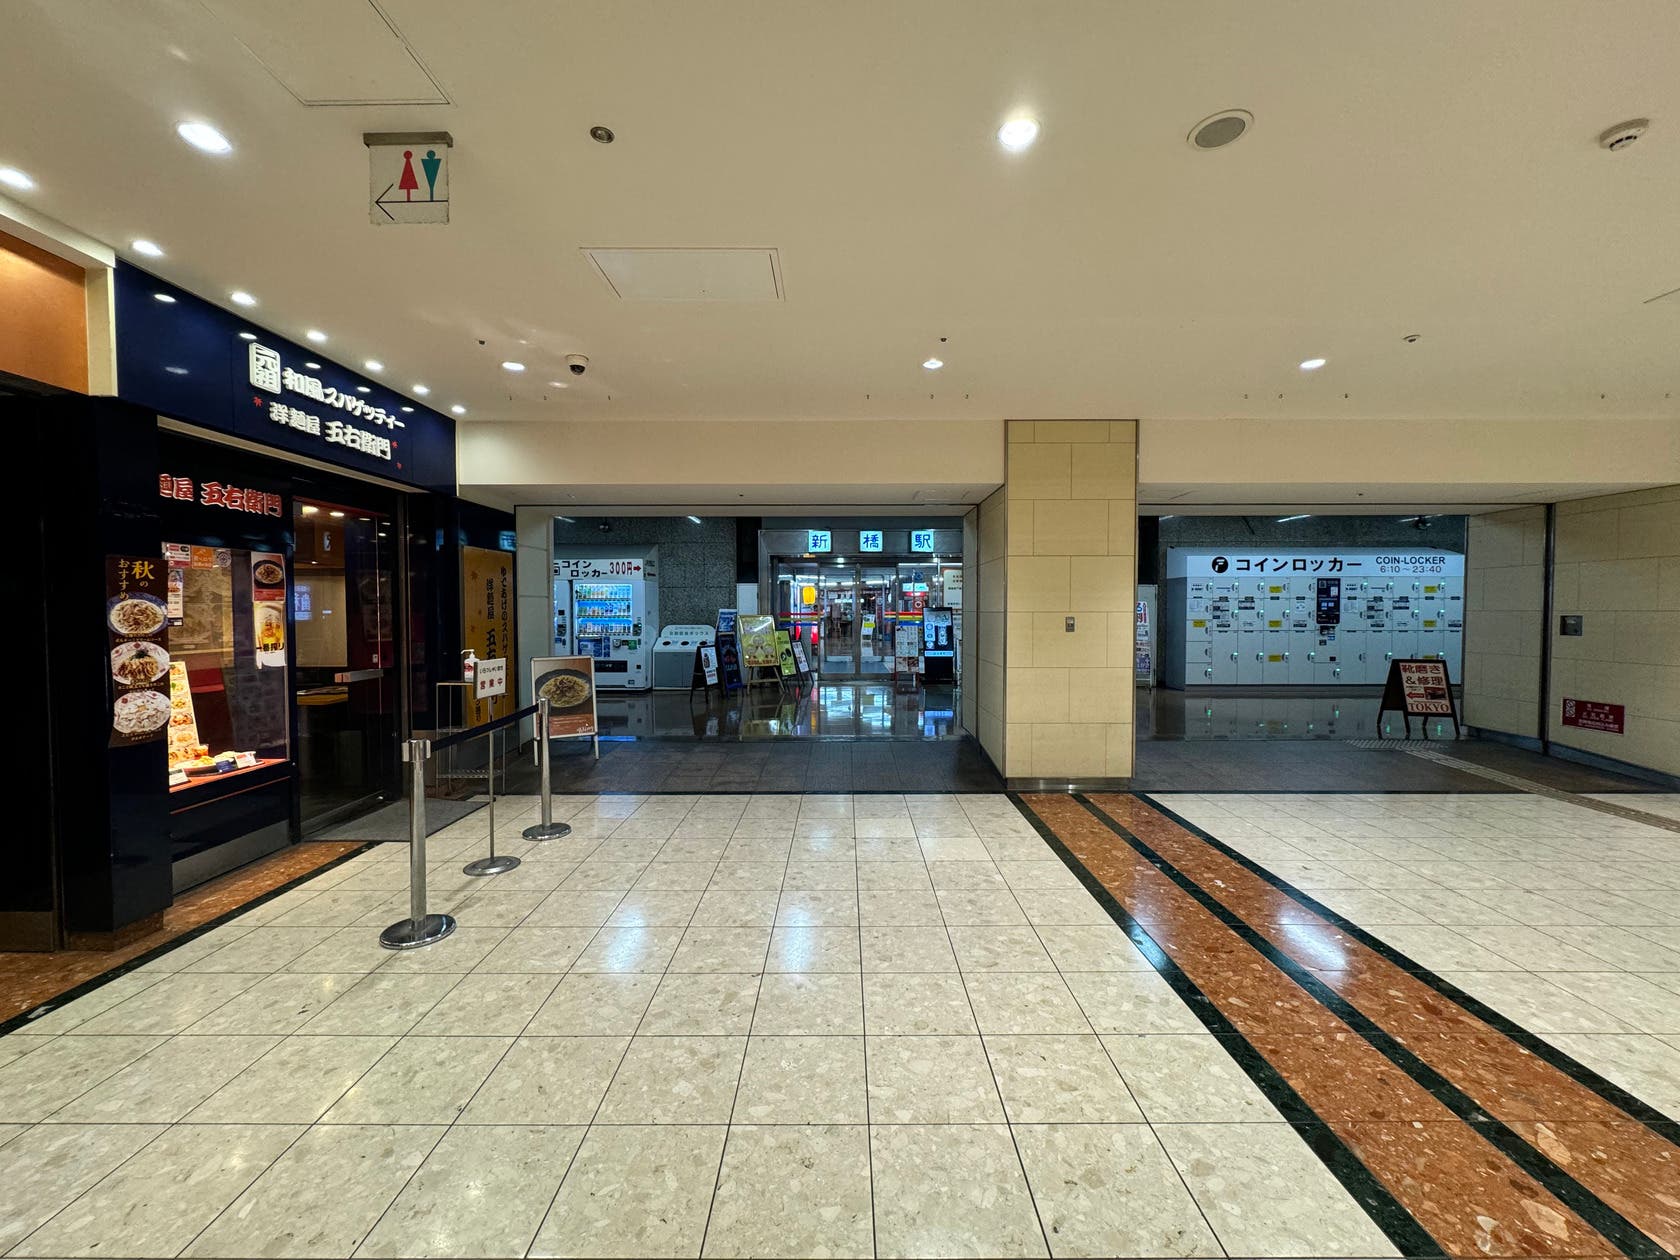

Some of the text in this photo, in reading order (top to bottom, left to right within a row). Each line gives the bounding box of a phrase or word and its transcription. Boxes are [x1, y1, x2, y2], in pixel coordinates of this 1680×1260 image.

[282, 367, 405, 429] 和風スパゲッティー
[324, 420, 392, 460] 五右衛門
[200, 481, 282, 517] 五右衛門
[131, 560, 155, 588] 秋の
[562, 560, 592, 569] コイン
[609, 561, 633, 575] 300円
[570, 569, 608, 578] ロッカー
[1236, 557, 1362, 572] コインロッカー
[1376, 556, 1446, 565] COIN-LOCKER
[118, 558, 130, 601] おすすめ
[1408, 702, 1450, 712] TOKYO
